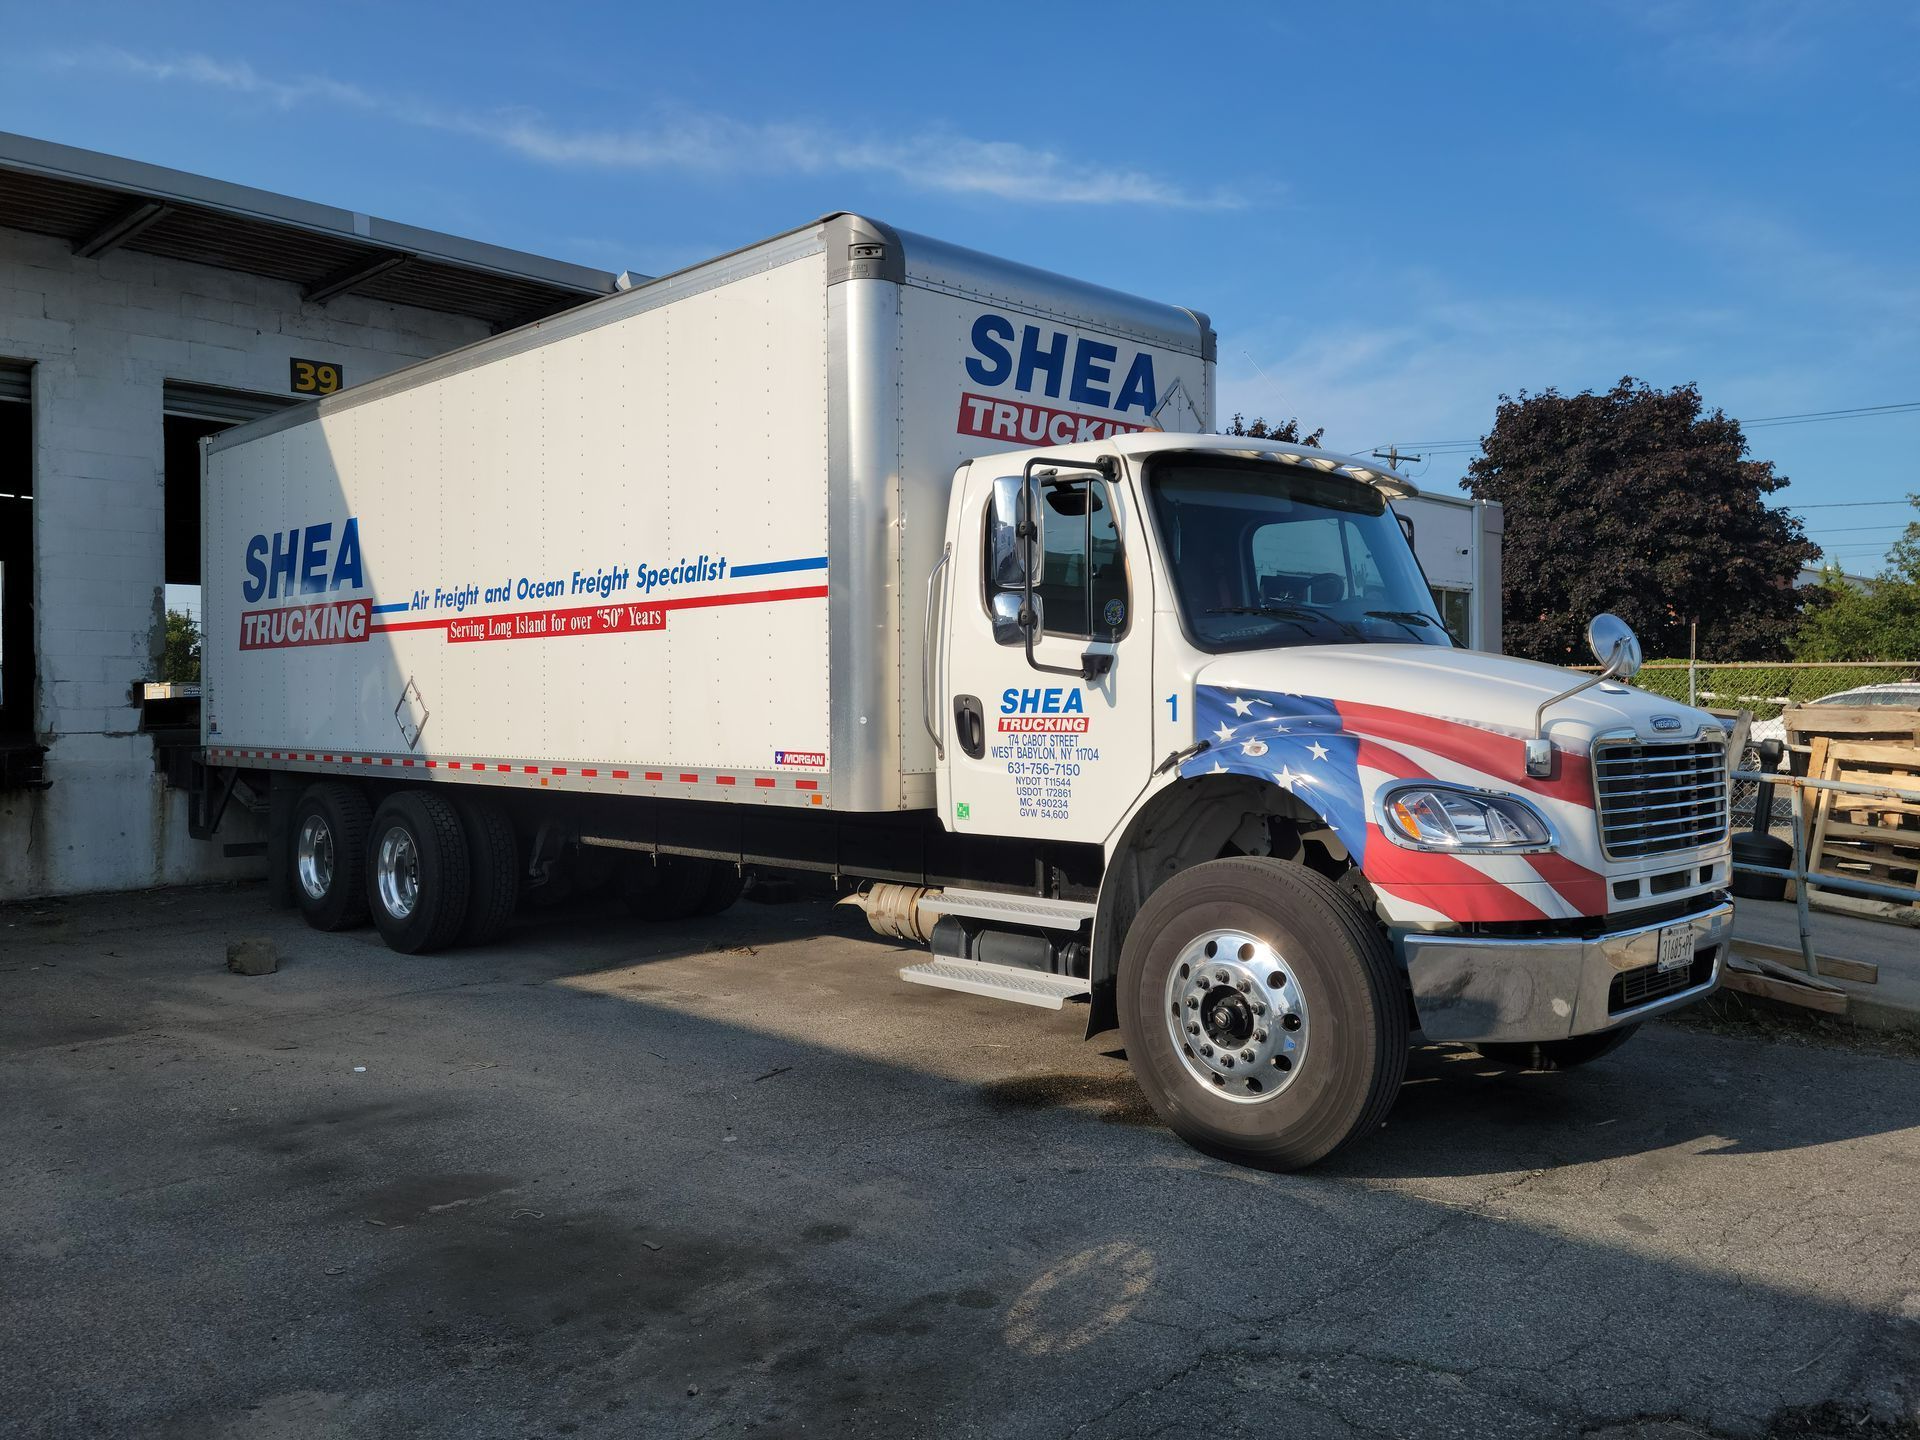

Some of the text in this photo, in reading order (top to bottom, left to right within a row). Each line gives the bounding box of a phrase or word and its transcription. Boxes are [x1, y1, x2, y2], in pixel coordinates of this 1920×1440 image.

[965, 314, 1157, 416] SHEA
[296, 363, 338, 394] 39
[967, 397, 1137, 445] TRUCK
[243, 517, 363, 603] SHEA
[411, 555, 727, 612] Air Freight and Ocean Freight Specialist
[244, 603, 366, 645] TRUCKING
[450, 620, 485, 640] Serving
[488, 618, 512, 638] Long
[516, 615, 547, 634] Island
[551, 613, 567, 631] for
[570, 615, 592, 630] over
[628, 607, 661, 626] Years
[1000, 688, 1084, 714] SHEA
[1166, 694, 1177, 722] 1
[1000, 718, 1086, 732] TRUCKING
[1008, 734, 1079, 747] 174 CABOT STREET
[784, 753, 825, 765] MORGAN
[991, 746, 1100, 761] WEST BABYLON, NY 11704
[1008, 762, 1081, 776] 631-756-7150
[1015, 776, 1071, 787] NYDOT T11544
[1016, 787, 1072, 798] USDOT 172861
[1019, 797, 1068, 809] MC 490234
[1019, 808, 1038, 818] GVW
